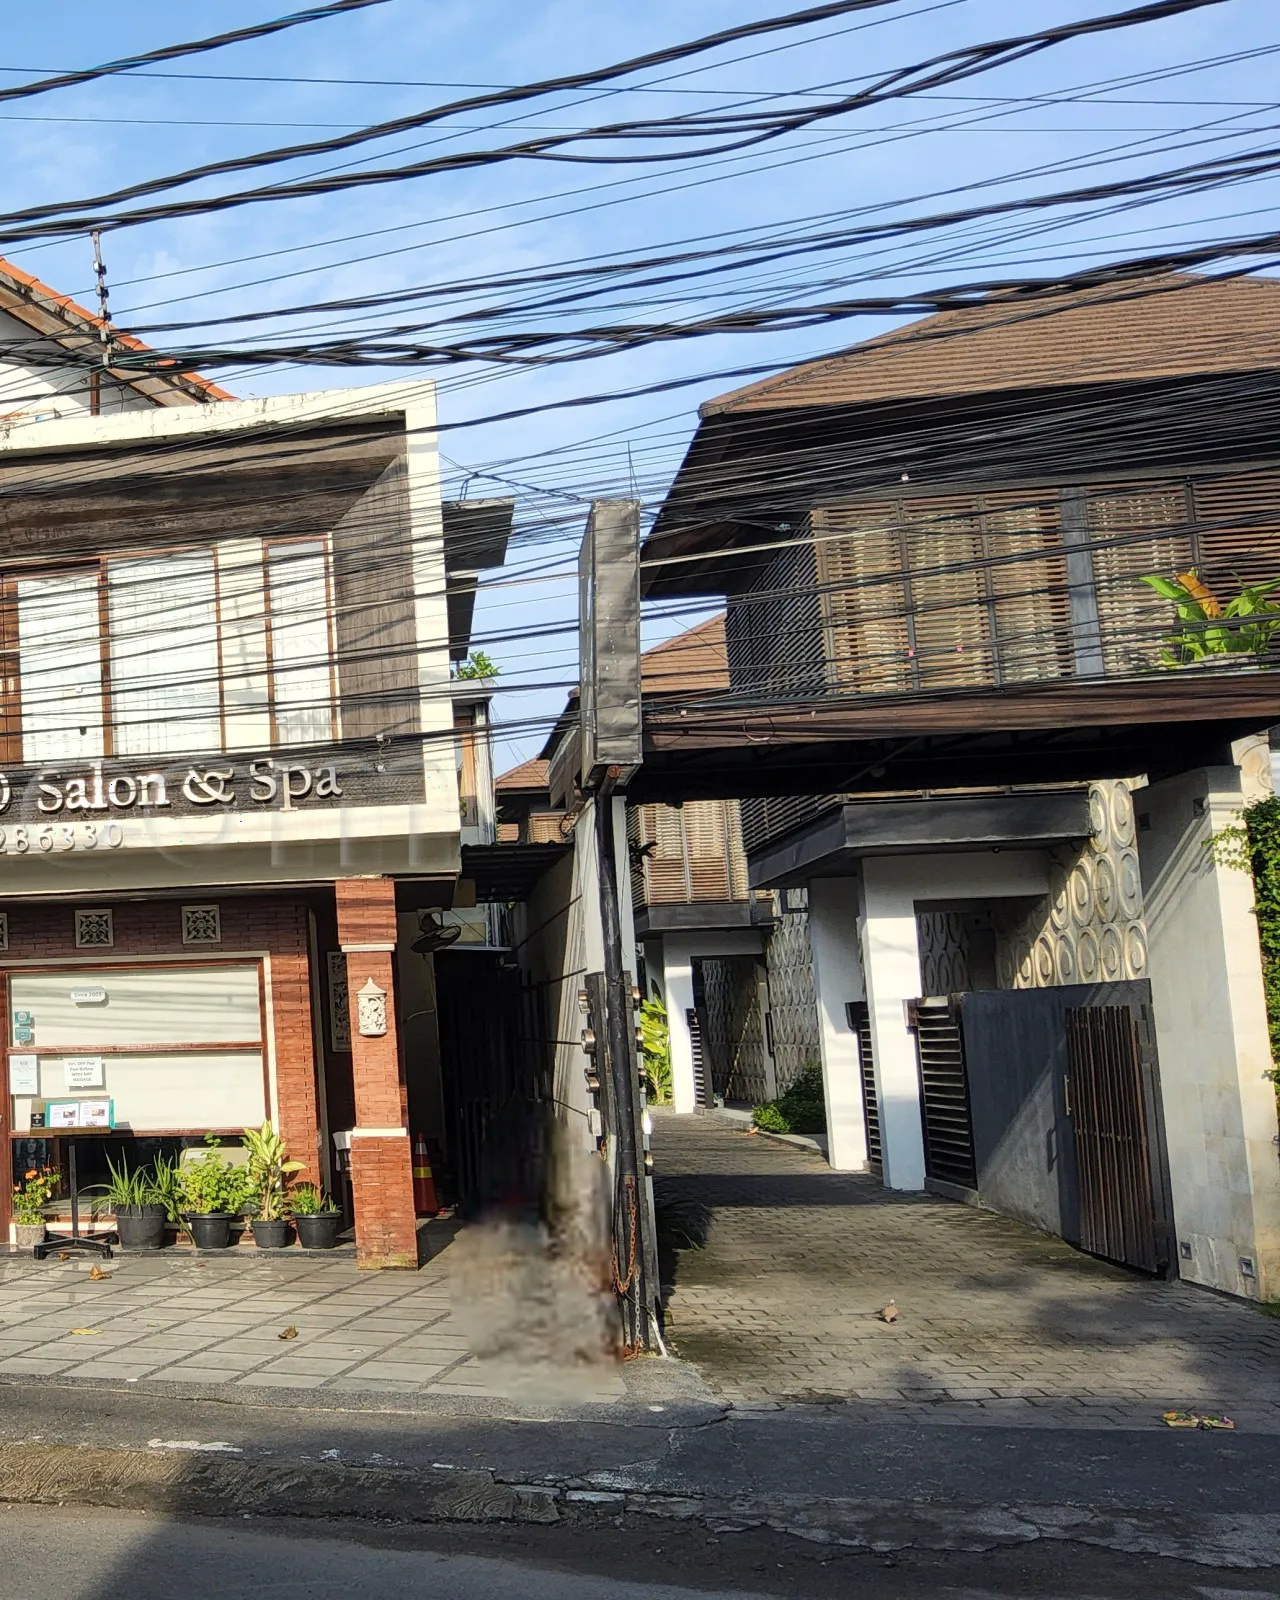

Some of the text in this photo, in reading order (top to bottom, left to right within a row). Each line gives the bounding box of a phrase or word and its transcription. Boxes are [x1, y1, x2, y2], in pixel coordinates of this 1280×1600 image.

[37, 761, 170, 813] Salon
[183, 765, 236, 804] &
[250, 758, 343, 812] Spa
